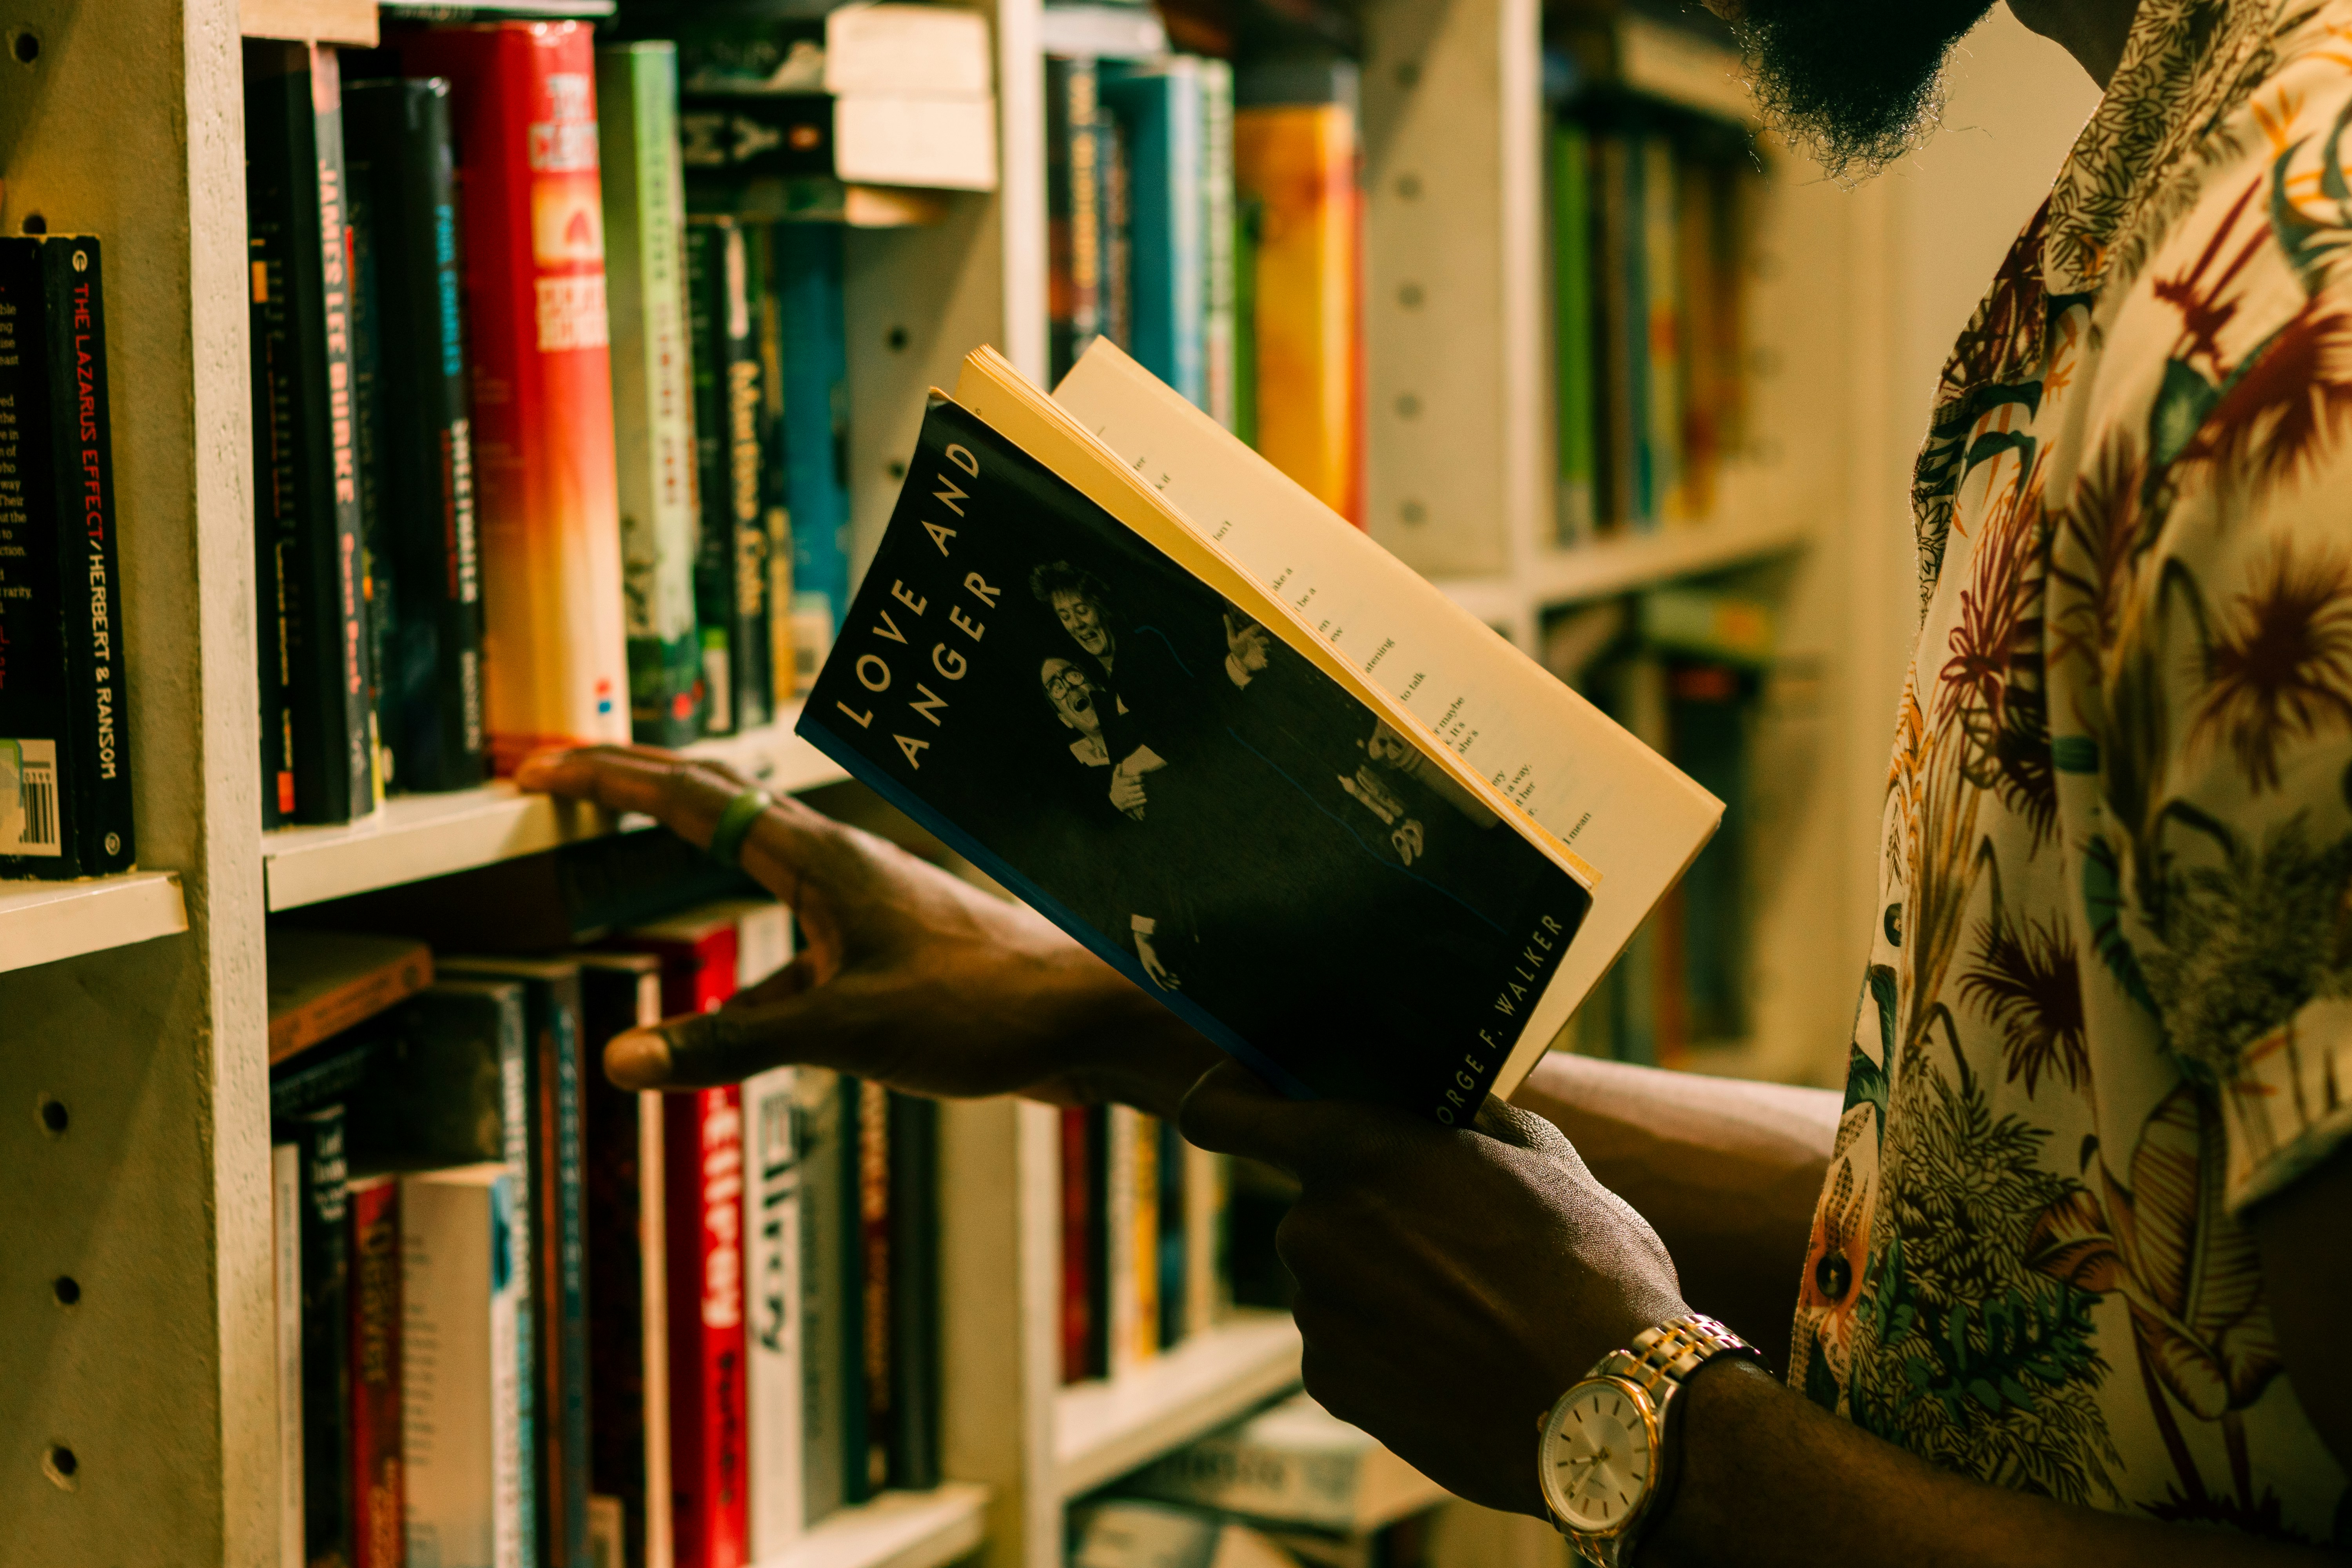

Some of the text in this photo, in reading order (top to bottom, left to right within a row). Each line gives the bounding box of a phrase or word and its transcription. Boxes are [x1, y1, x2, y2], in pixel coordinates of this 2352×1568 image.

[74, 283, 90, 329] THE
[319, 159, 355, 503] JAMES LEE BURKE
[74, 335, 97, 442] LAZARUS
[837, 443, 979, 729] LOVE AND
[1272, 567, 1293, 591] ake a
[1297, 593, 1310, 608] be
[892, 572, 1001, 770] ANGER
[1365, 637, 1396, 673] atening
[95, 667, 110, 683] &
[1400, 671, 1426, 702] to talk
[1439, 696, 1465, 728] maybe
[96, 687, 116, 780] RANSOM
[1450, 721, 1466, 737] It's
[1458, 729, 1479, 754] she's
[1508, 764, 1532, 792] a way,
[1521, 782, 1536, 800] her
[1563, 812, 1592, 846] I mean
[1436, 915, 1563, 1125] ORGE F. WALKER
